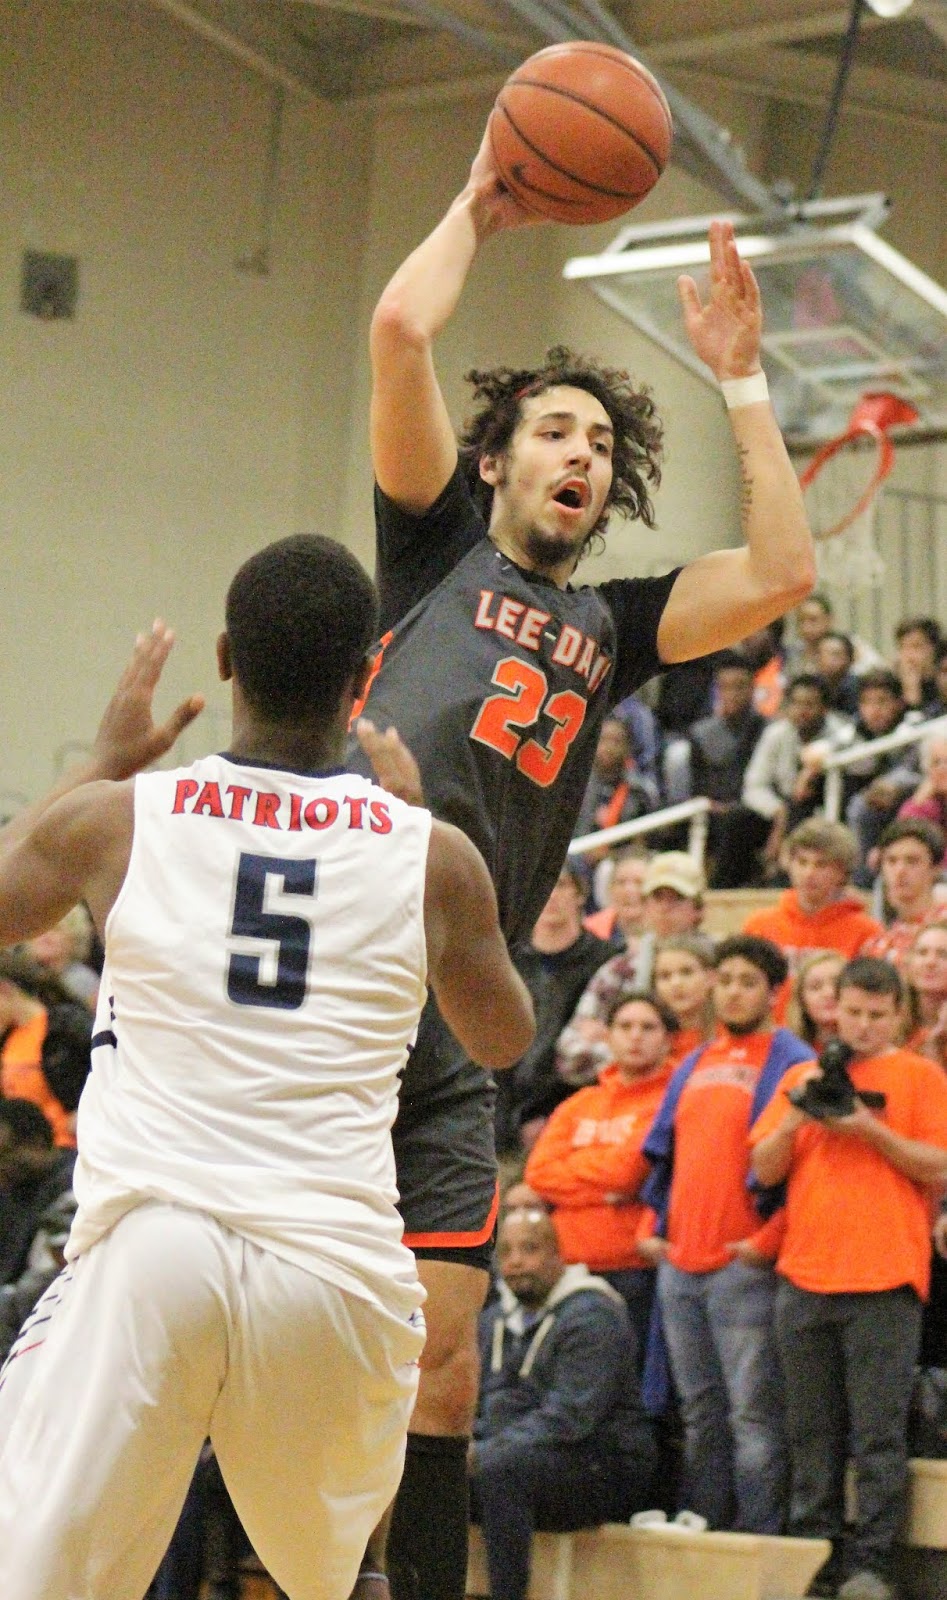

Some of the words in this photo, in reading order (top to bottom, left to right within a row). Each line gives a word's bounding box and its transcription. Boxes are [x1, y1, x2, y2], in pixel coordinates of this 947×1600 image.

[469, 655, 588, 788] 23
[171, 778, 393, 835] PATRIOTS
[226, 850, 319, 1011] 5
